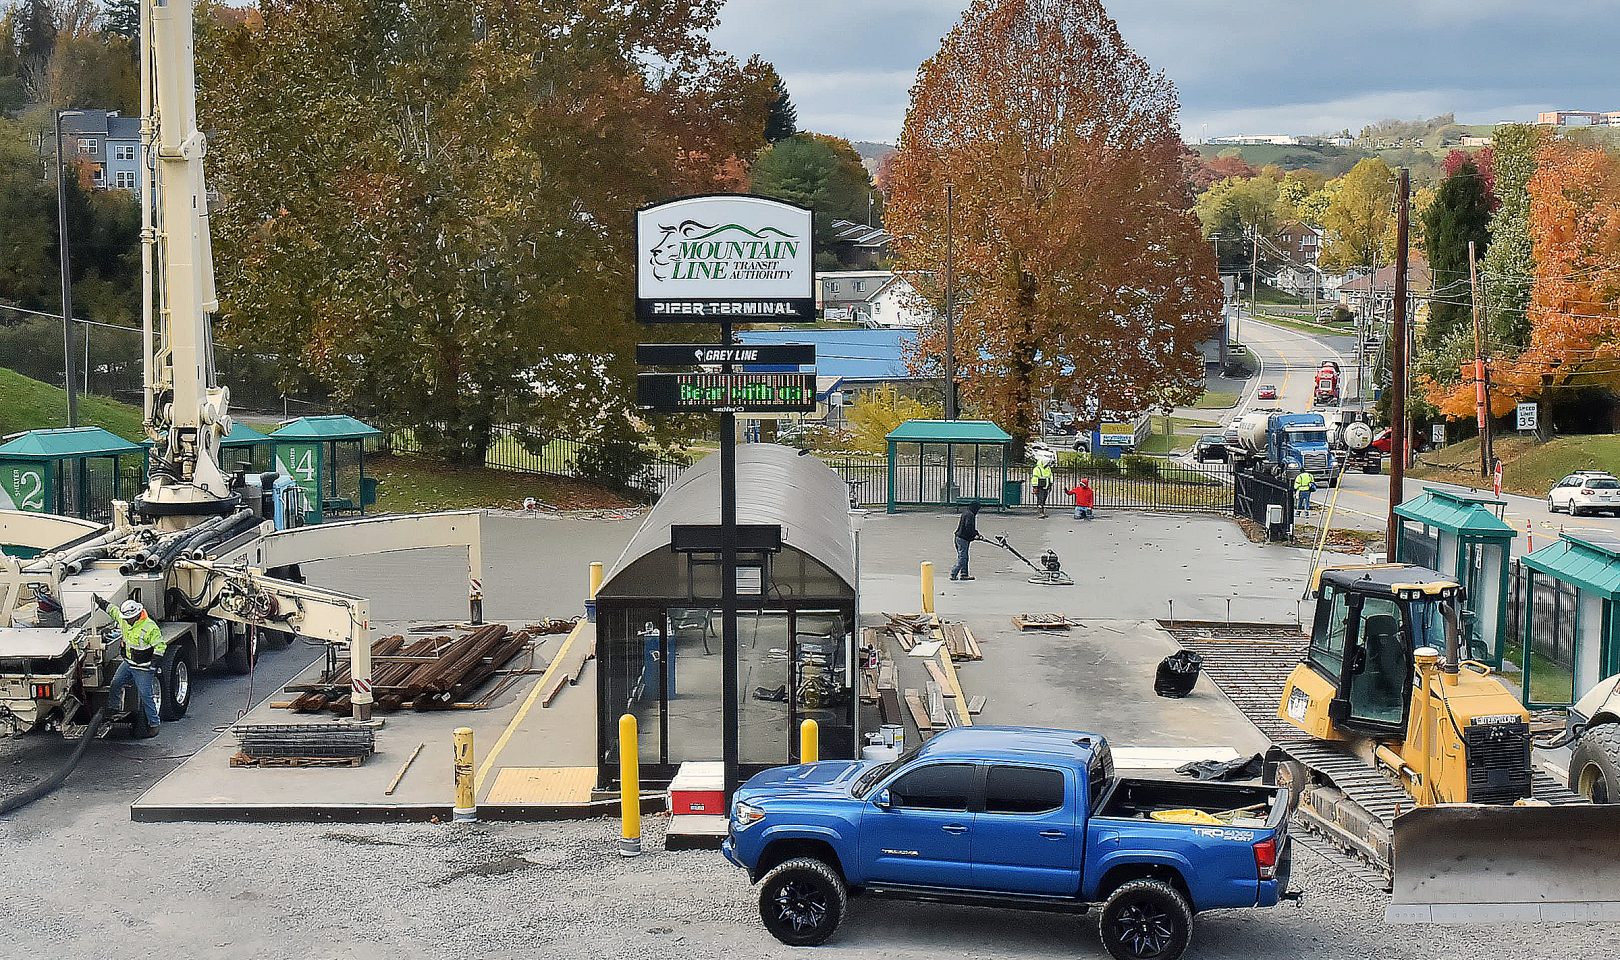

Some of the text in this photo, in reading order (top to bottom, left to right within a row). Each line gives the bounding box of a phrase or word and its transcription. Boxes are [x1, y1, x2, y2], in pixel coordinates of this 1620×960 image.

[677, 241, 799, 259] MOUNTAIN
[671, 261, 728, 280] LINE
[733, 261, 779, 270] TRANSIT
[729, 270, 793, 280] AUTHORITY
[654, 302, 796, 315] PIFER TERMINAL
[706, 349, 759, 361] GREY LINE
[1519, 416, 1535, 427] 35
[295, 449, 315, 481] 4
[20, 471, 43, 510] 2
